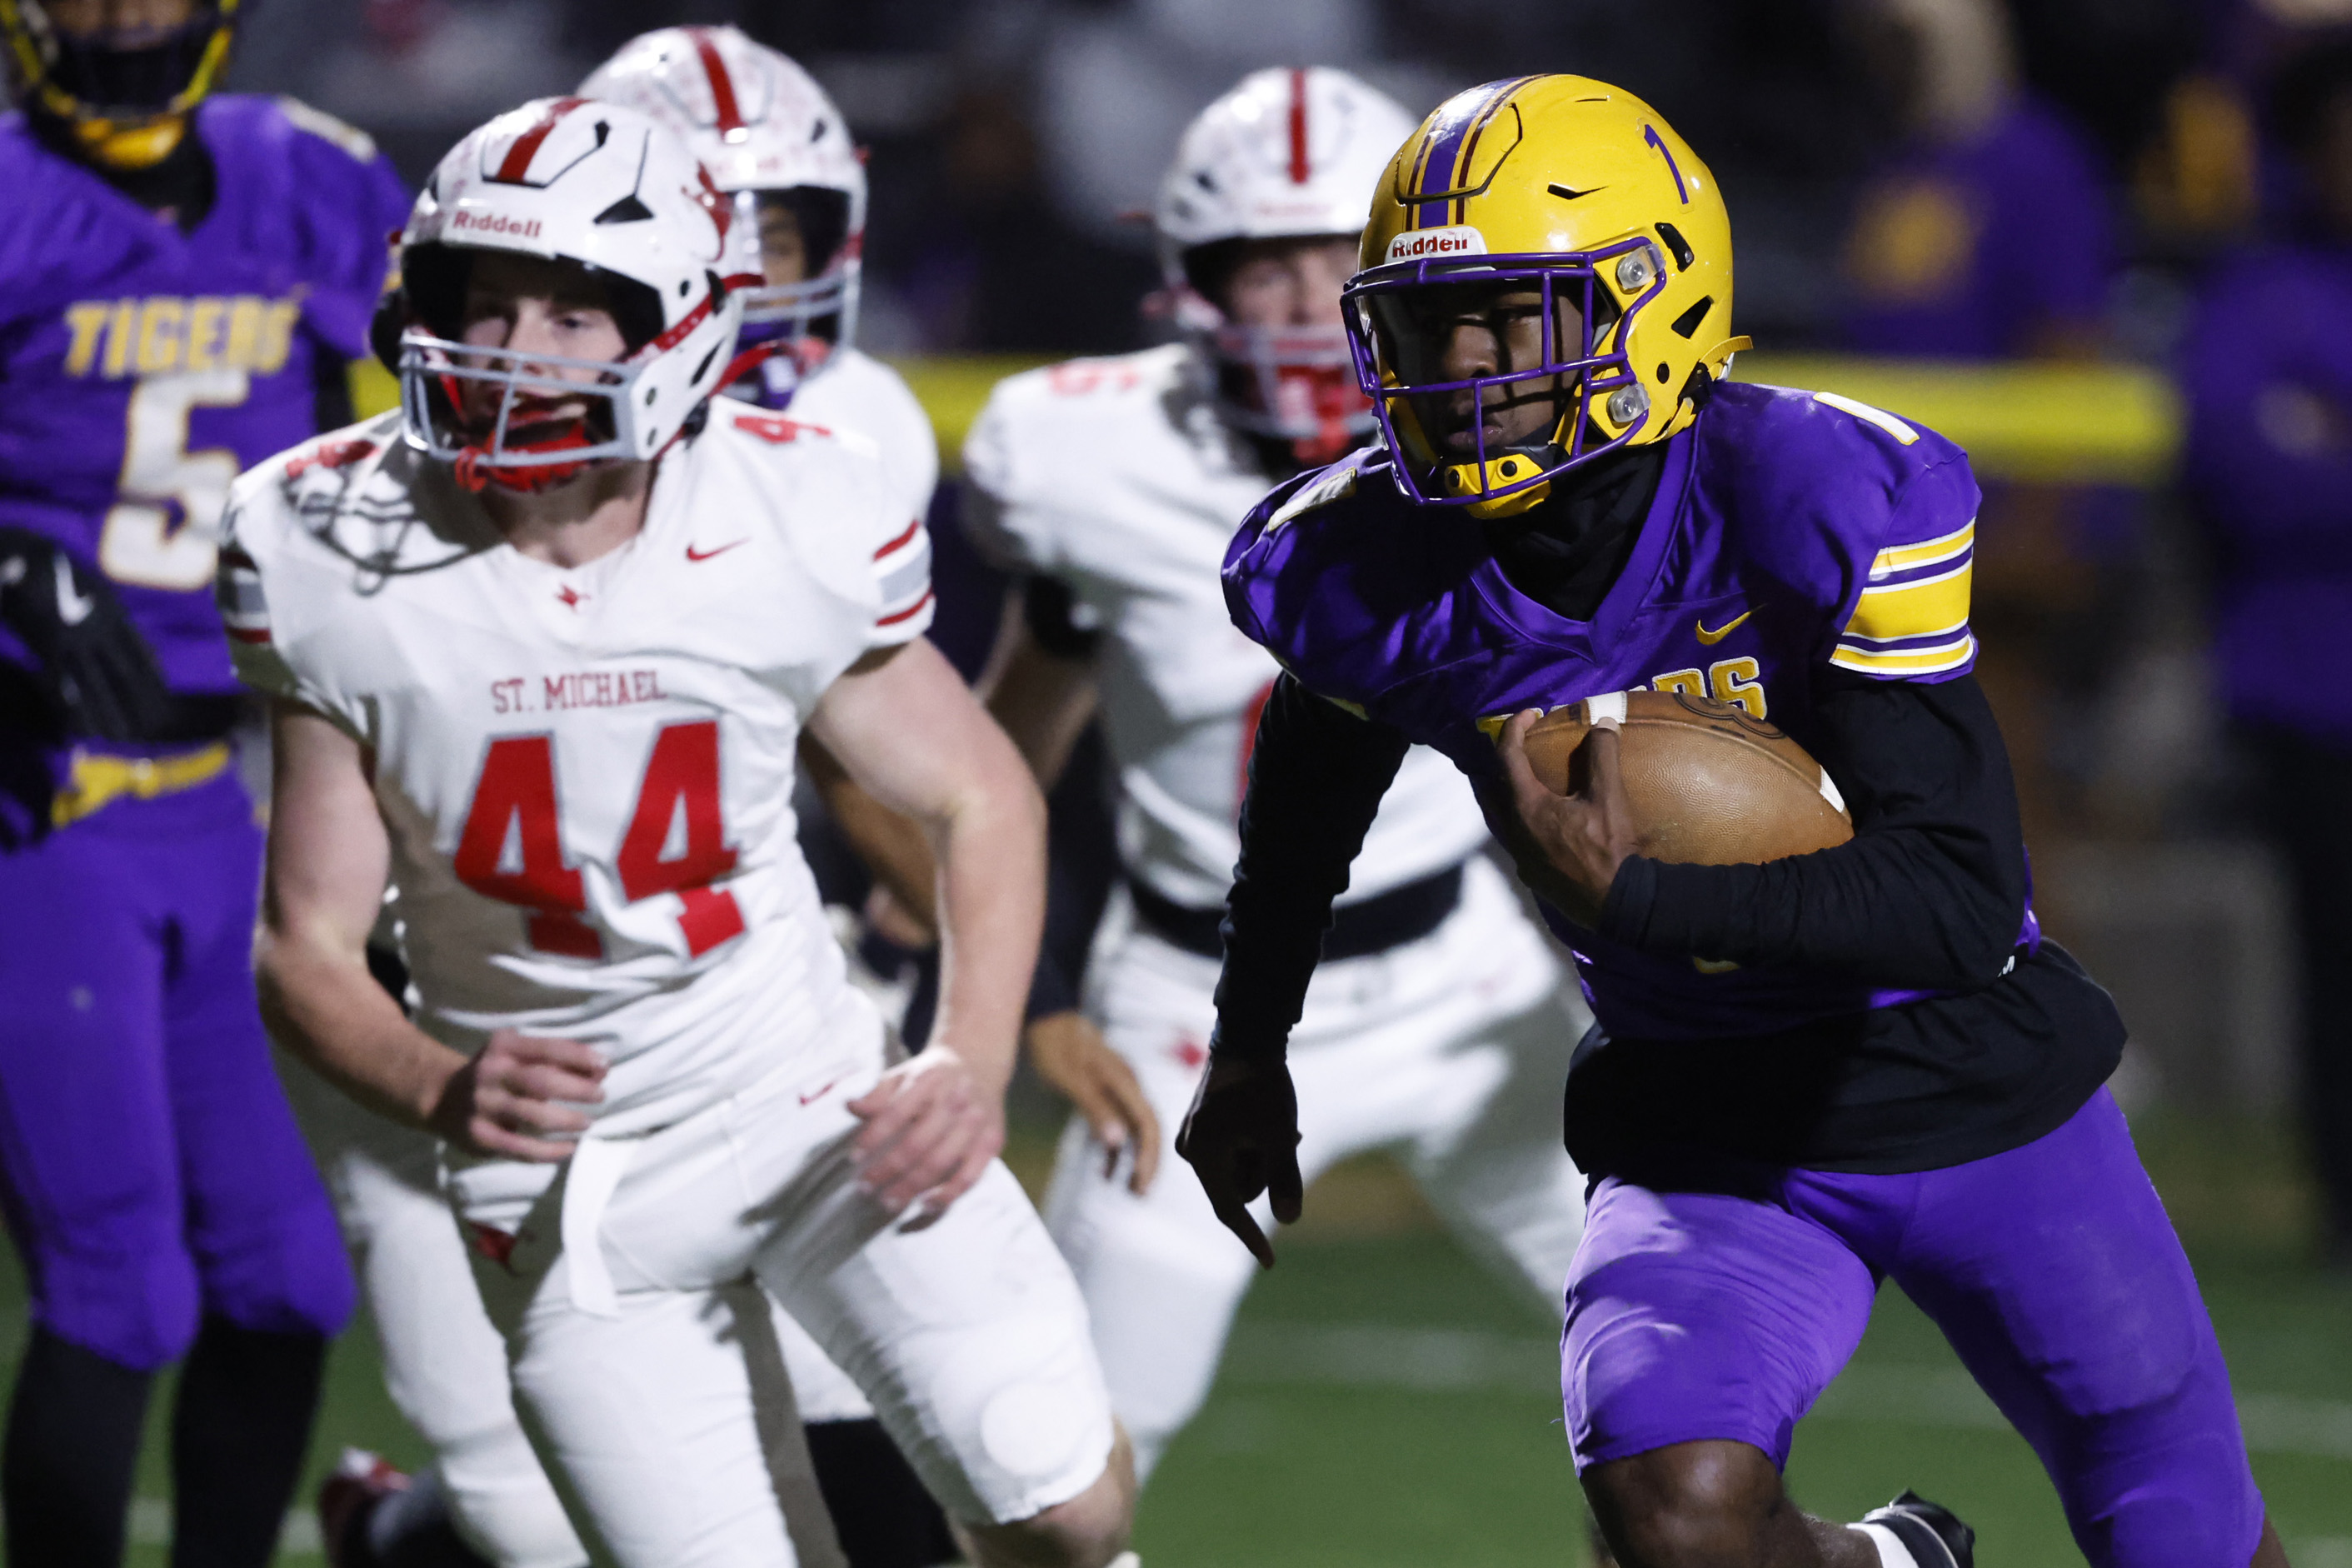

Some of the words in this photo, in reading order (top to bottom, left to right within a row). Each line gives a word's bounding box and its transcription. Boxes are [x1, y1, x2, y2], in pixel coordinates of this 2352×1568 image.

[452, 210, 543, 237] Riddell
[1391, 235, 1468, 258] Riddell
[65, 296, 302, 378] TIGERS
[97, 367, 251, 593] 5
[491, 677, 534, 714] ST.
[542, 670, 669, 712] MICHAEL
[452, 718, 748, 961] 44
